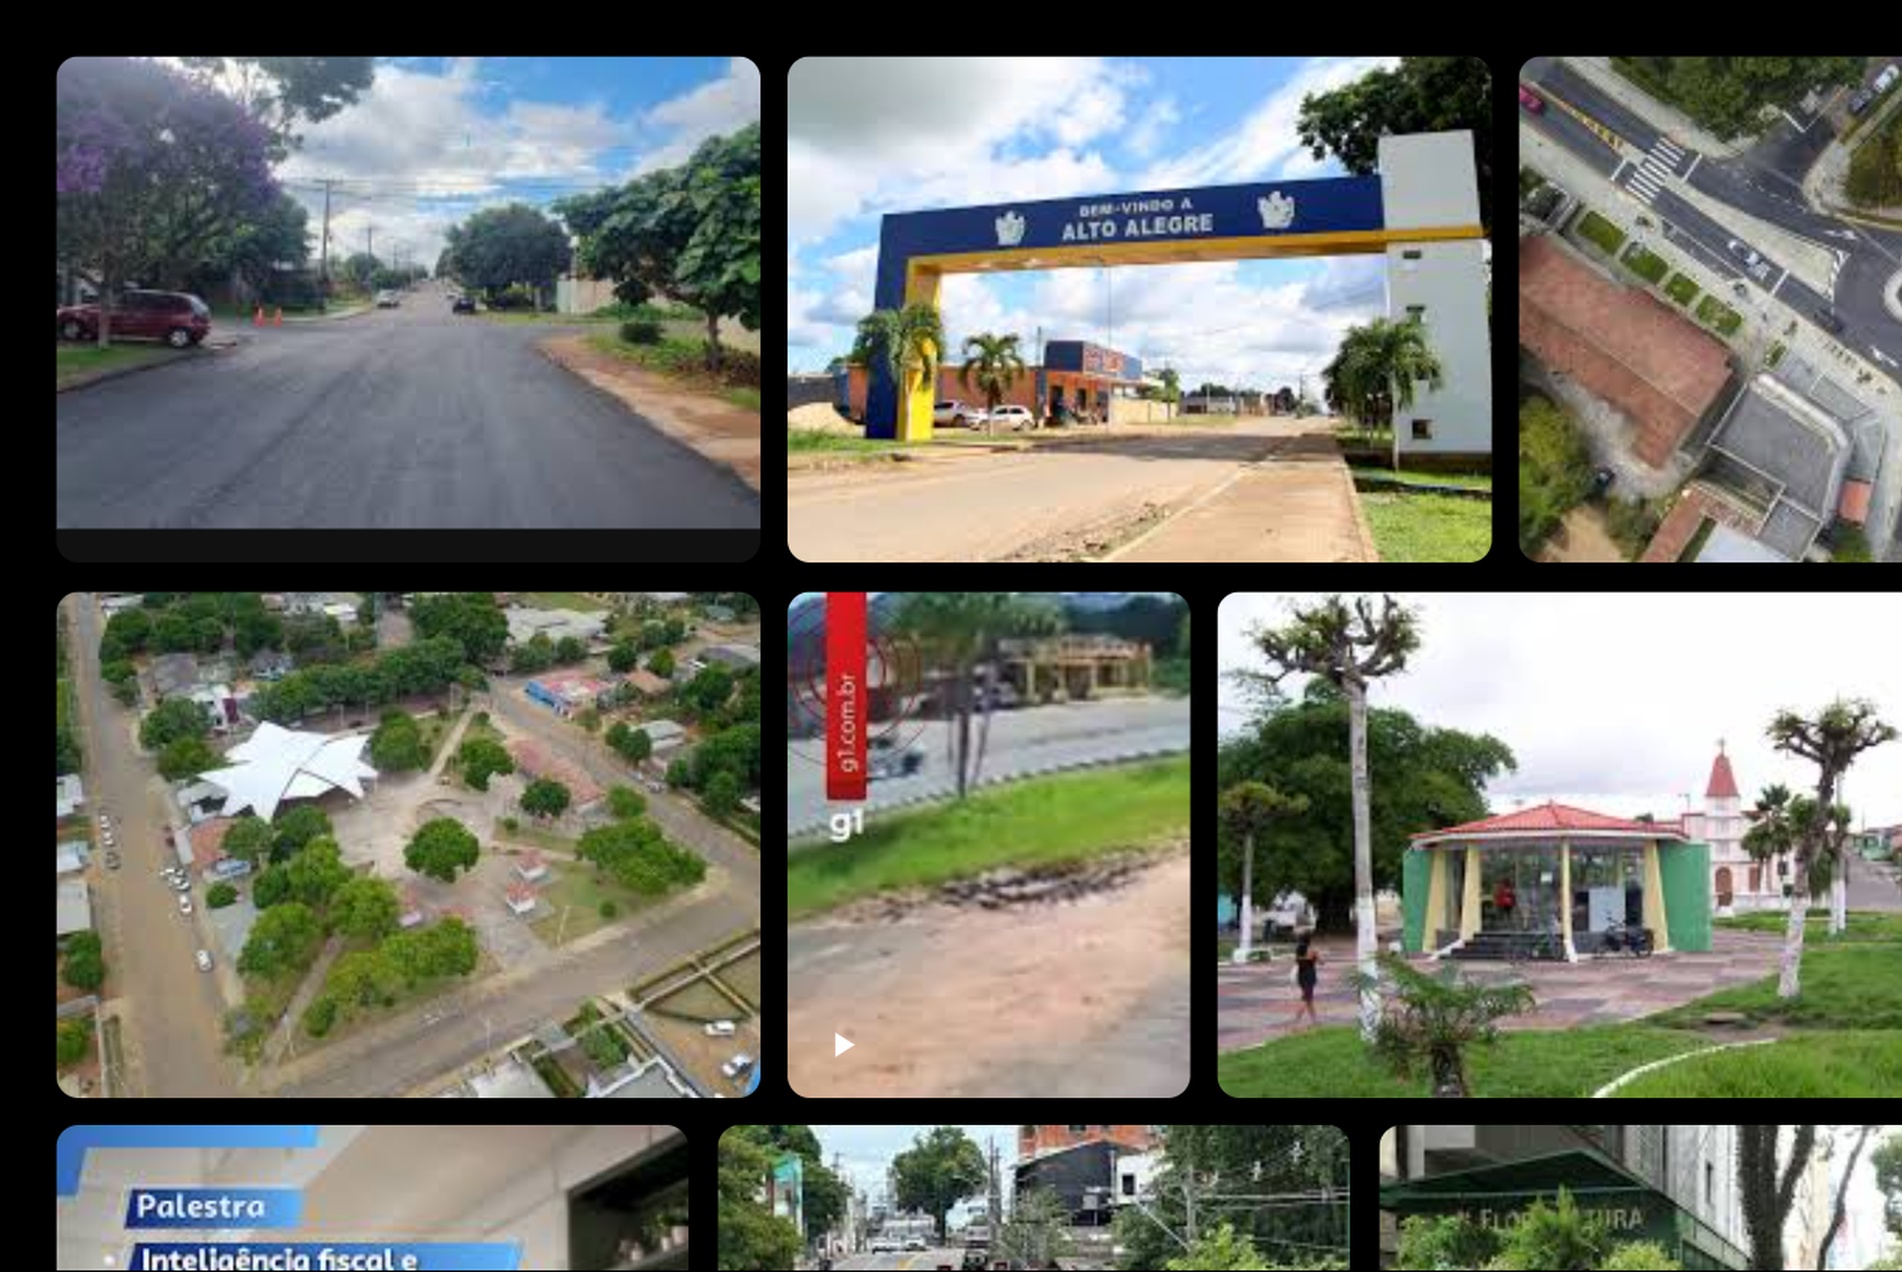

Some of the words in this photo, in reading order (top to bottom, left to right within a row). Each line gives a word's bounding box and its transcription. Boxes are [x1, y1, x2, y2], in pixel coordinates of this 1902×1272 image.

[1079, 199, 1174, 217] BEM-VINDO
[1180, 197, 1193, 210] A
[1062, 219, 1117, 241] ALTO
[1124, 213, 1214, 238] ALEGRE
